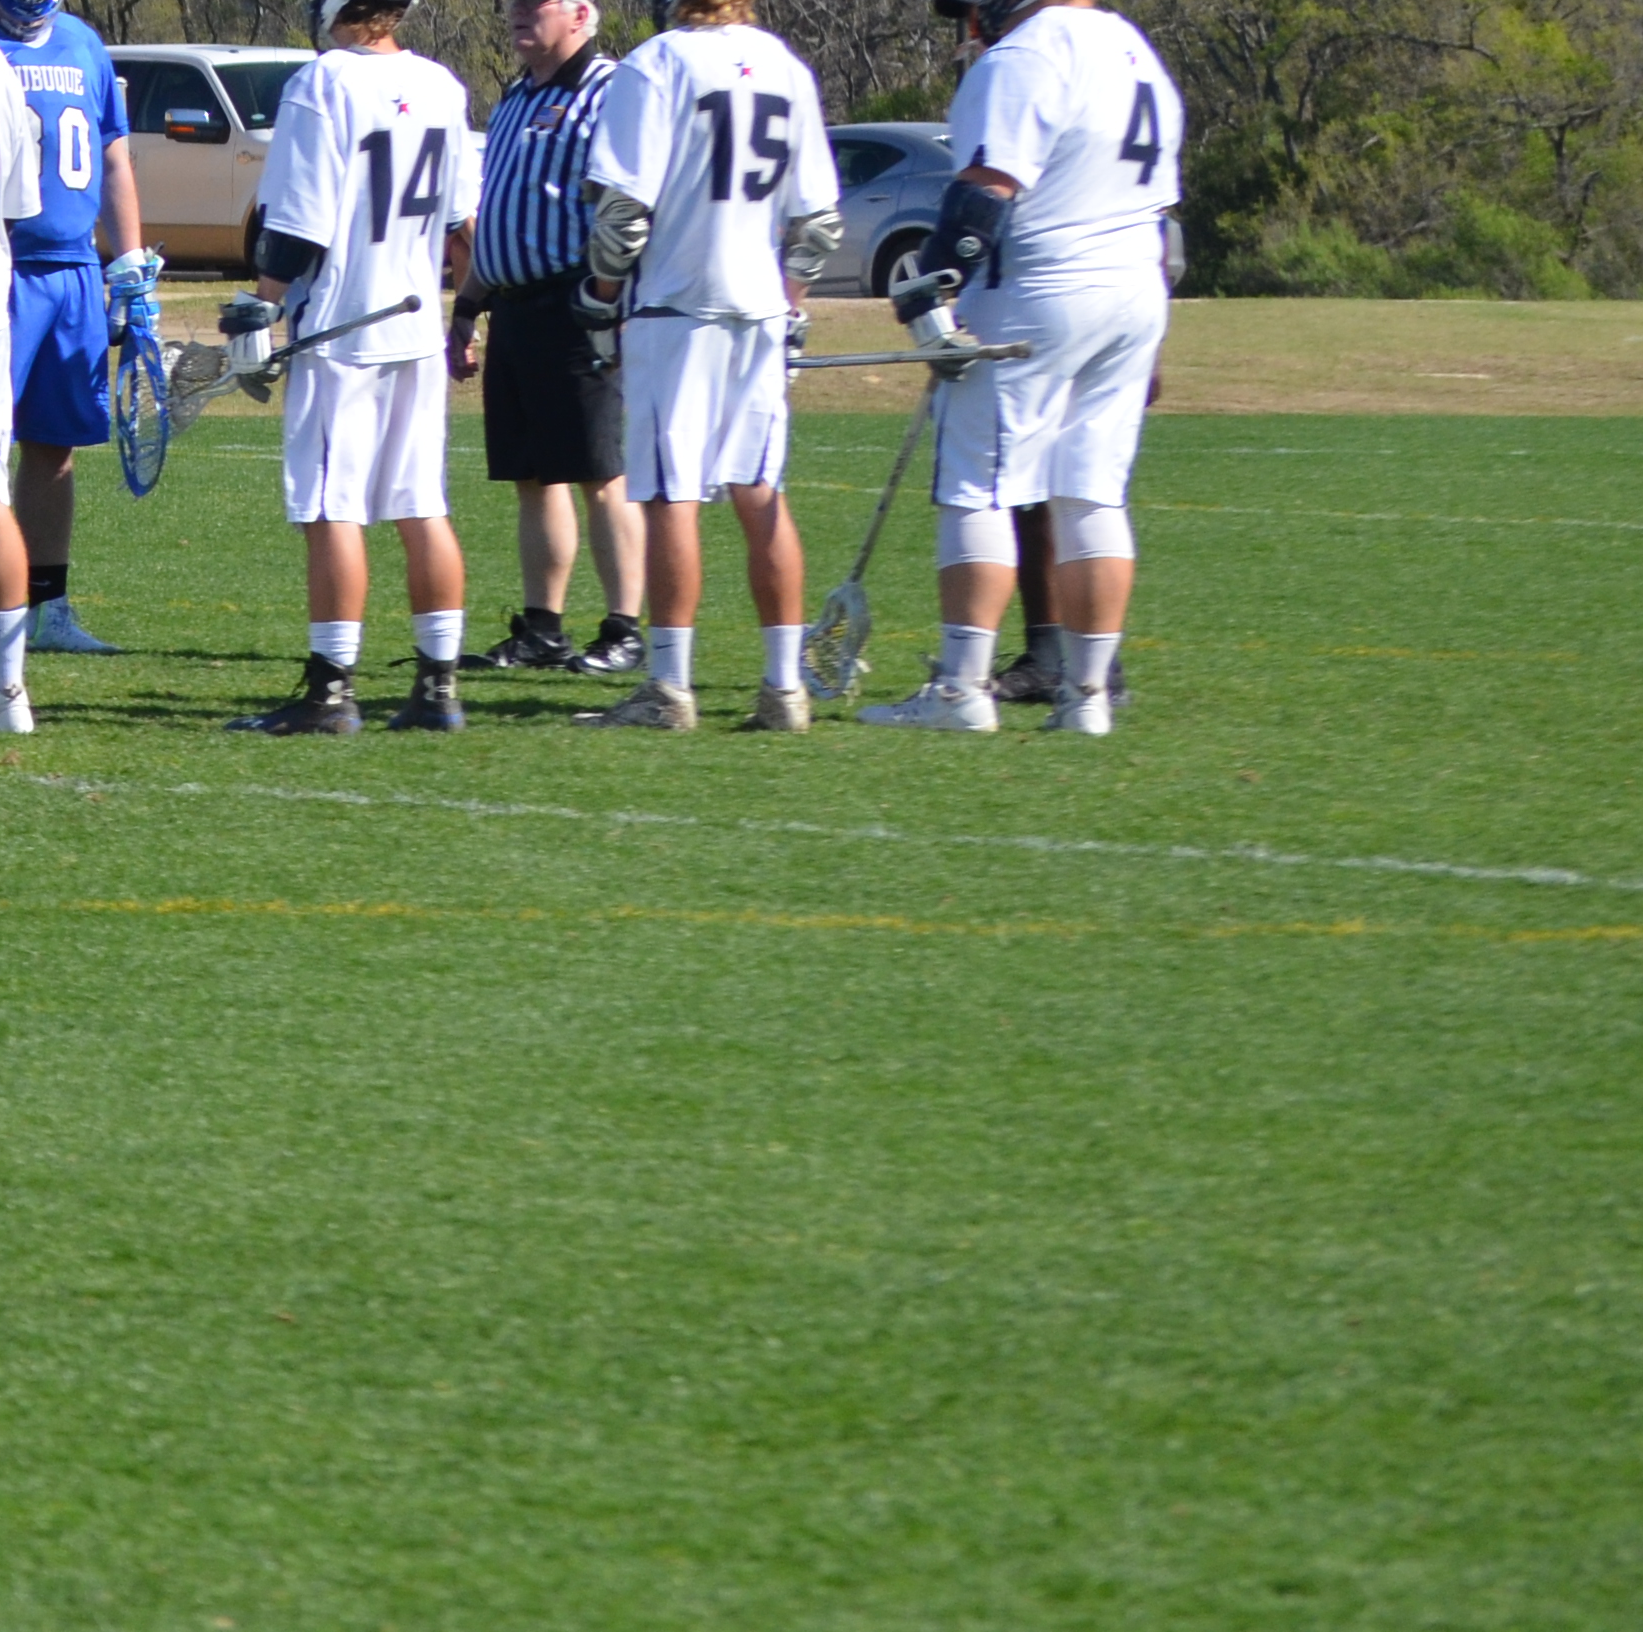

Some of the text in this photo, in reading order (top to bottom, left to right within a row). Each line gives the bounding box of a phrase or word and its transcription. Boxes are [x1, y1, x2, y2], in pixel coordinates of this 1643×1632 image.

[14, 64, 84, 96] UBUQUE
[1118, 81, 1163, 186] 4
[359, 126, 448, 244] 14
[696, 89, 792, 203] 15
